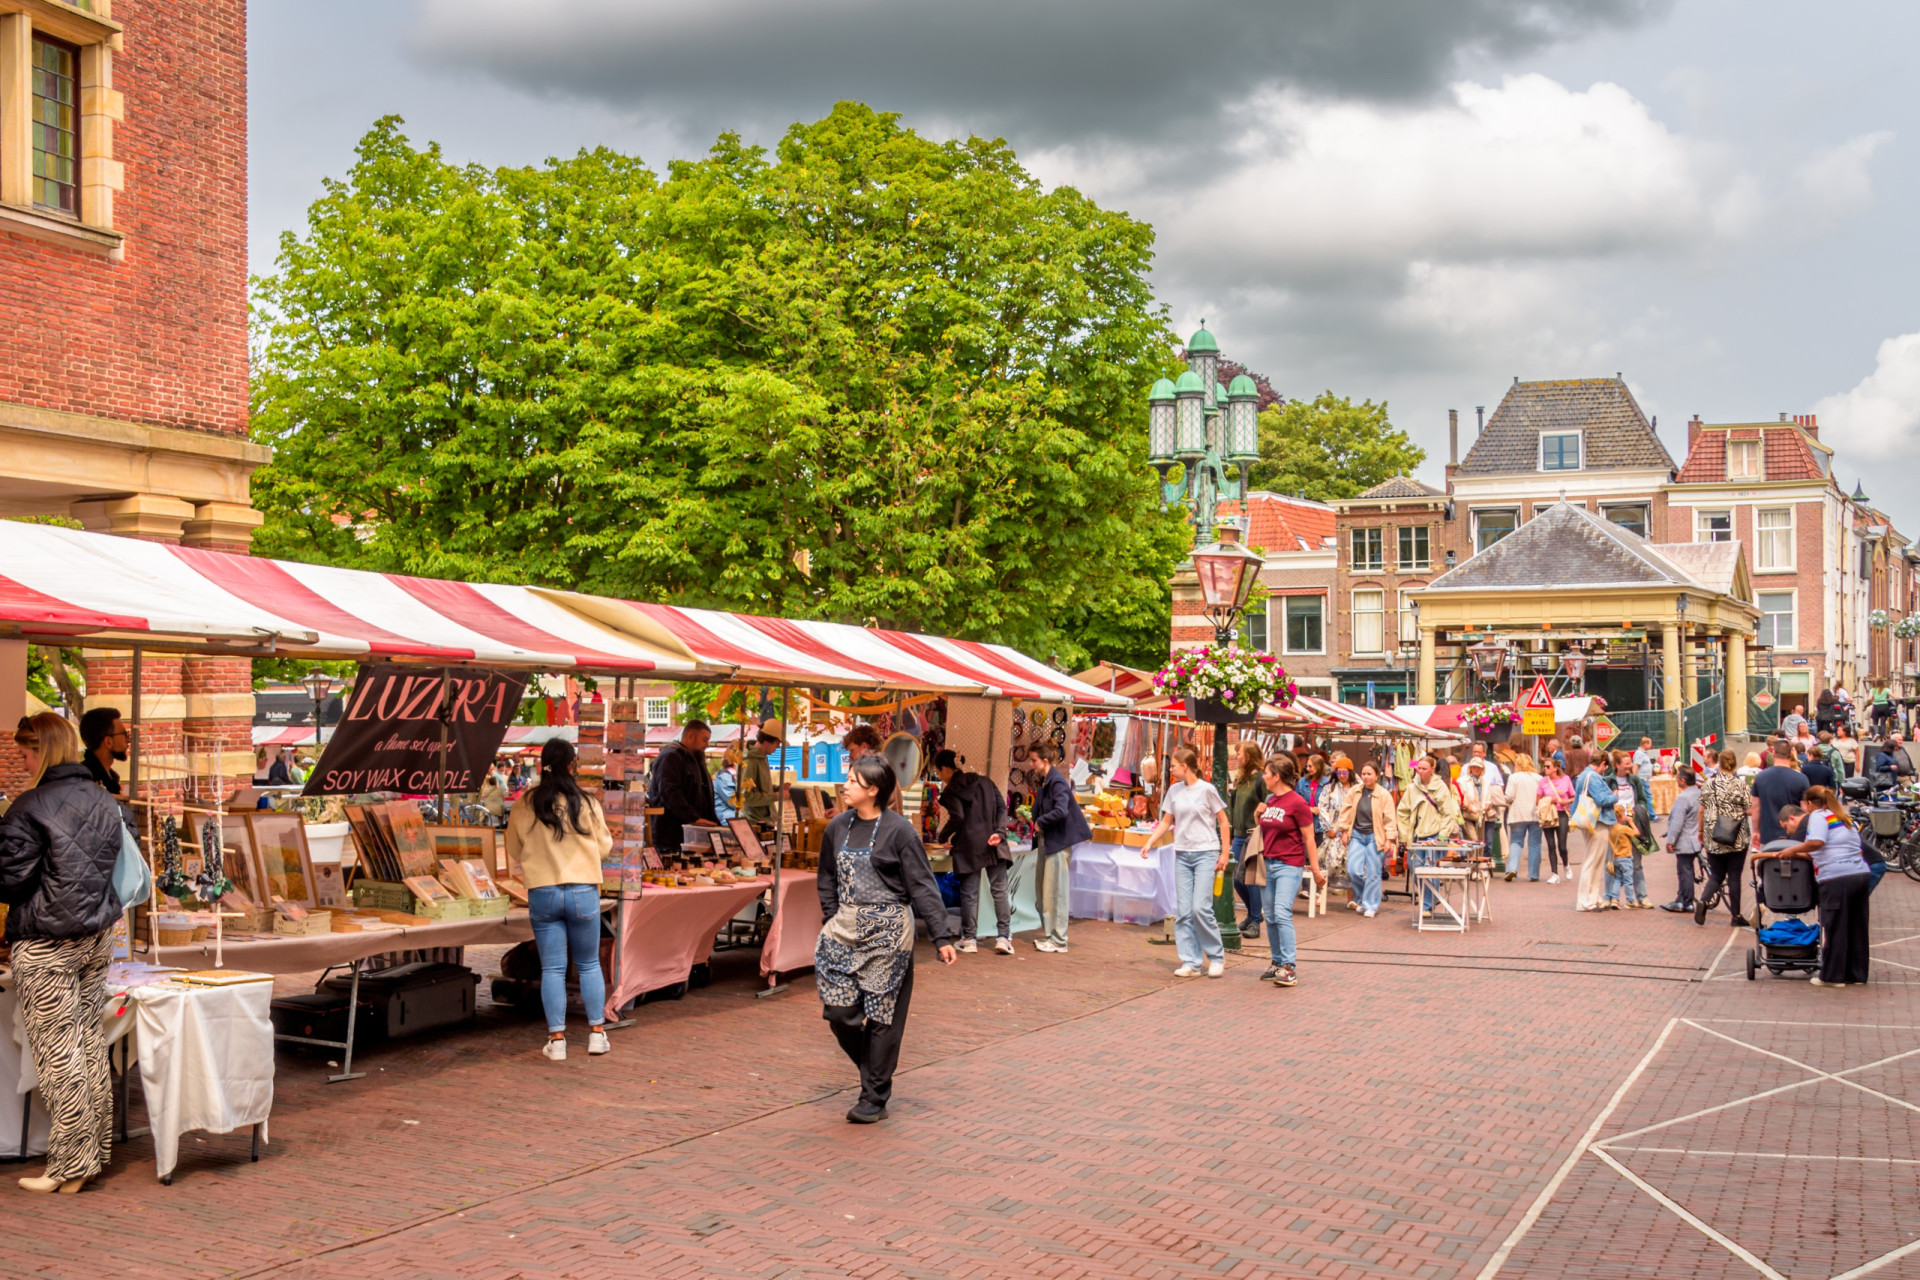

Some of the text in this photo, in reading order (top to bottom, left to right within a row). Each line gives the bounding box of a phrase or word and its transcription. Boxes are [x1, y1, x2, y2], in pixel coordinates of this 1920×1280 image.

[374, 732, 457, 760] a flame set aprt
[323, 768, 471, 791] SOY WAX CANDLE
